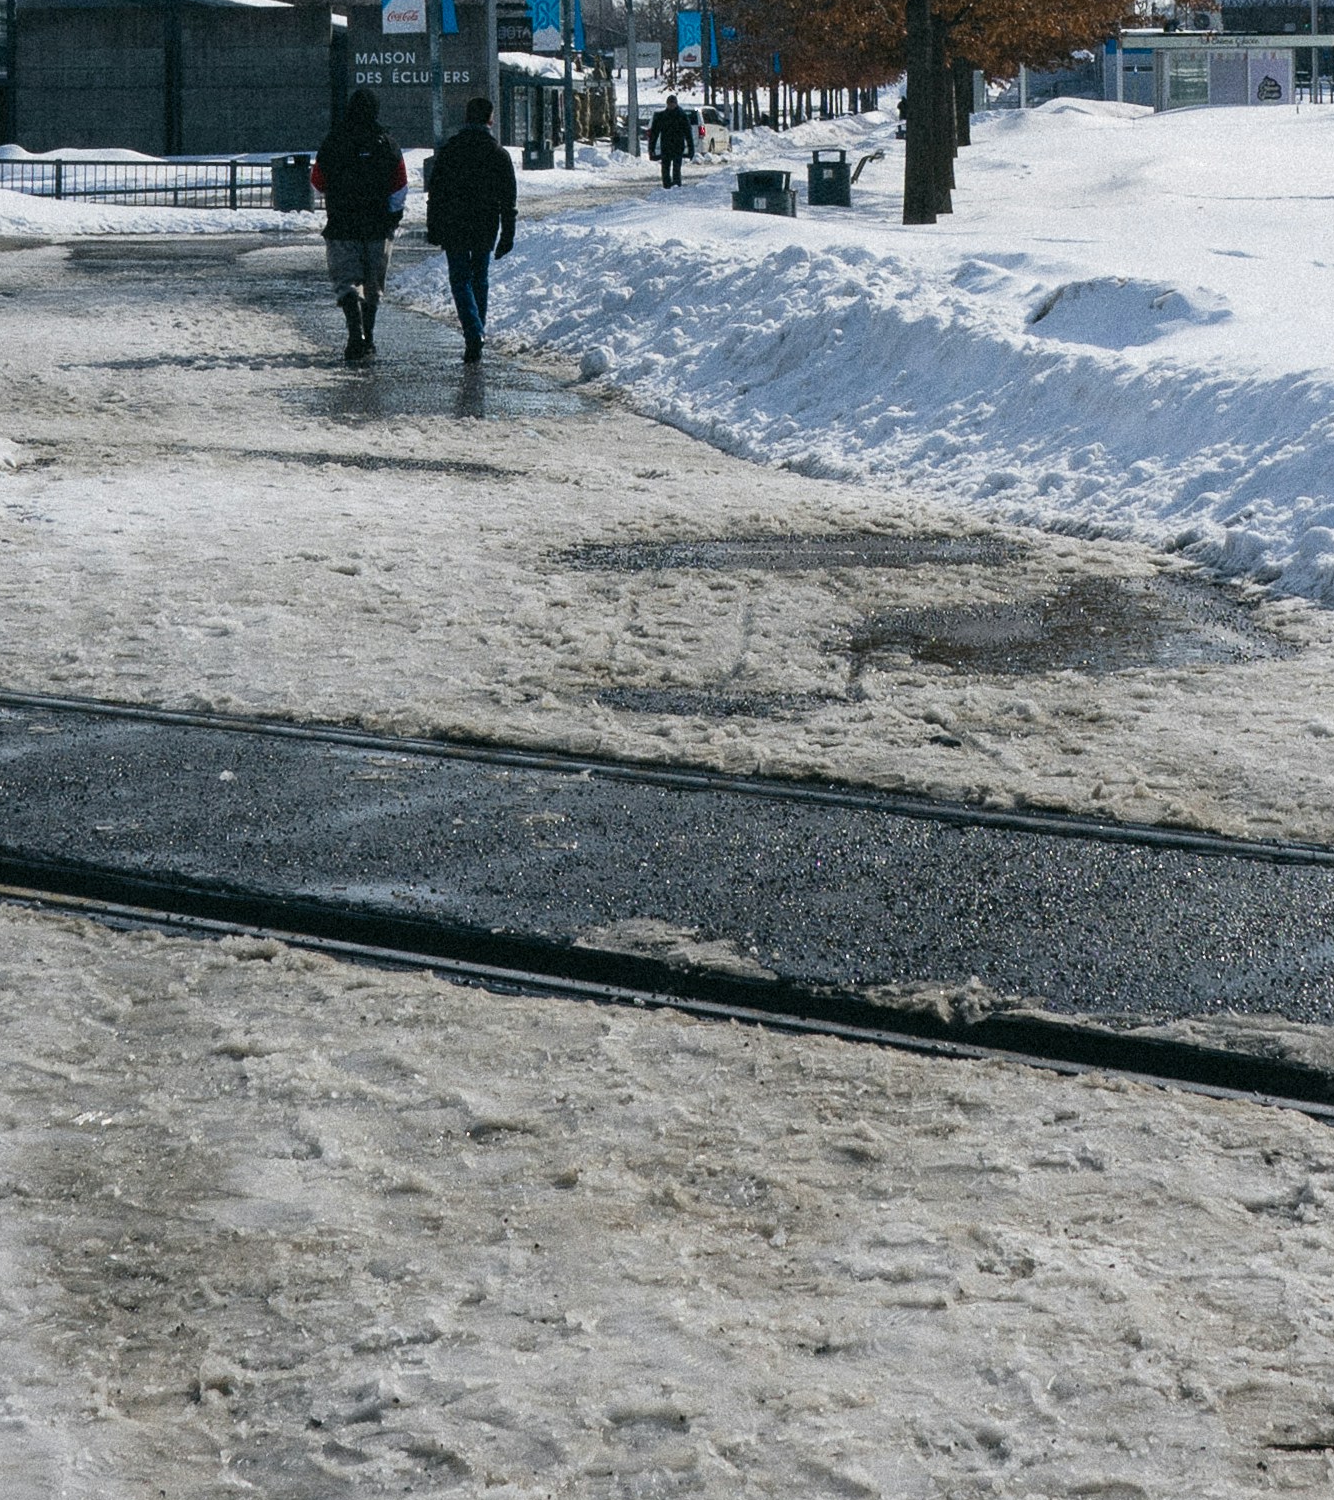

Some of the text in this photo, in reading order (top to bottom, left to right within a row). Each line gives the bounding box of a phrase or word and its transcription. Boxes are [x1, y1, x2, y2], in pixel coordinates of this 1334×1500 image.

[355, 51, 416, 65] MAISON
[355, 68, 471, 84] DES ÉCLUERS
